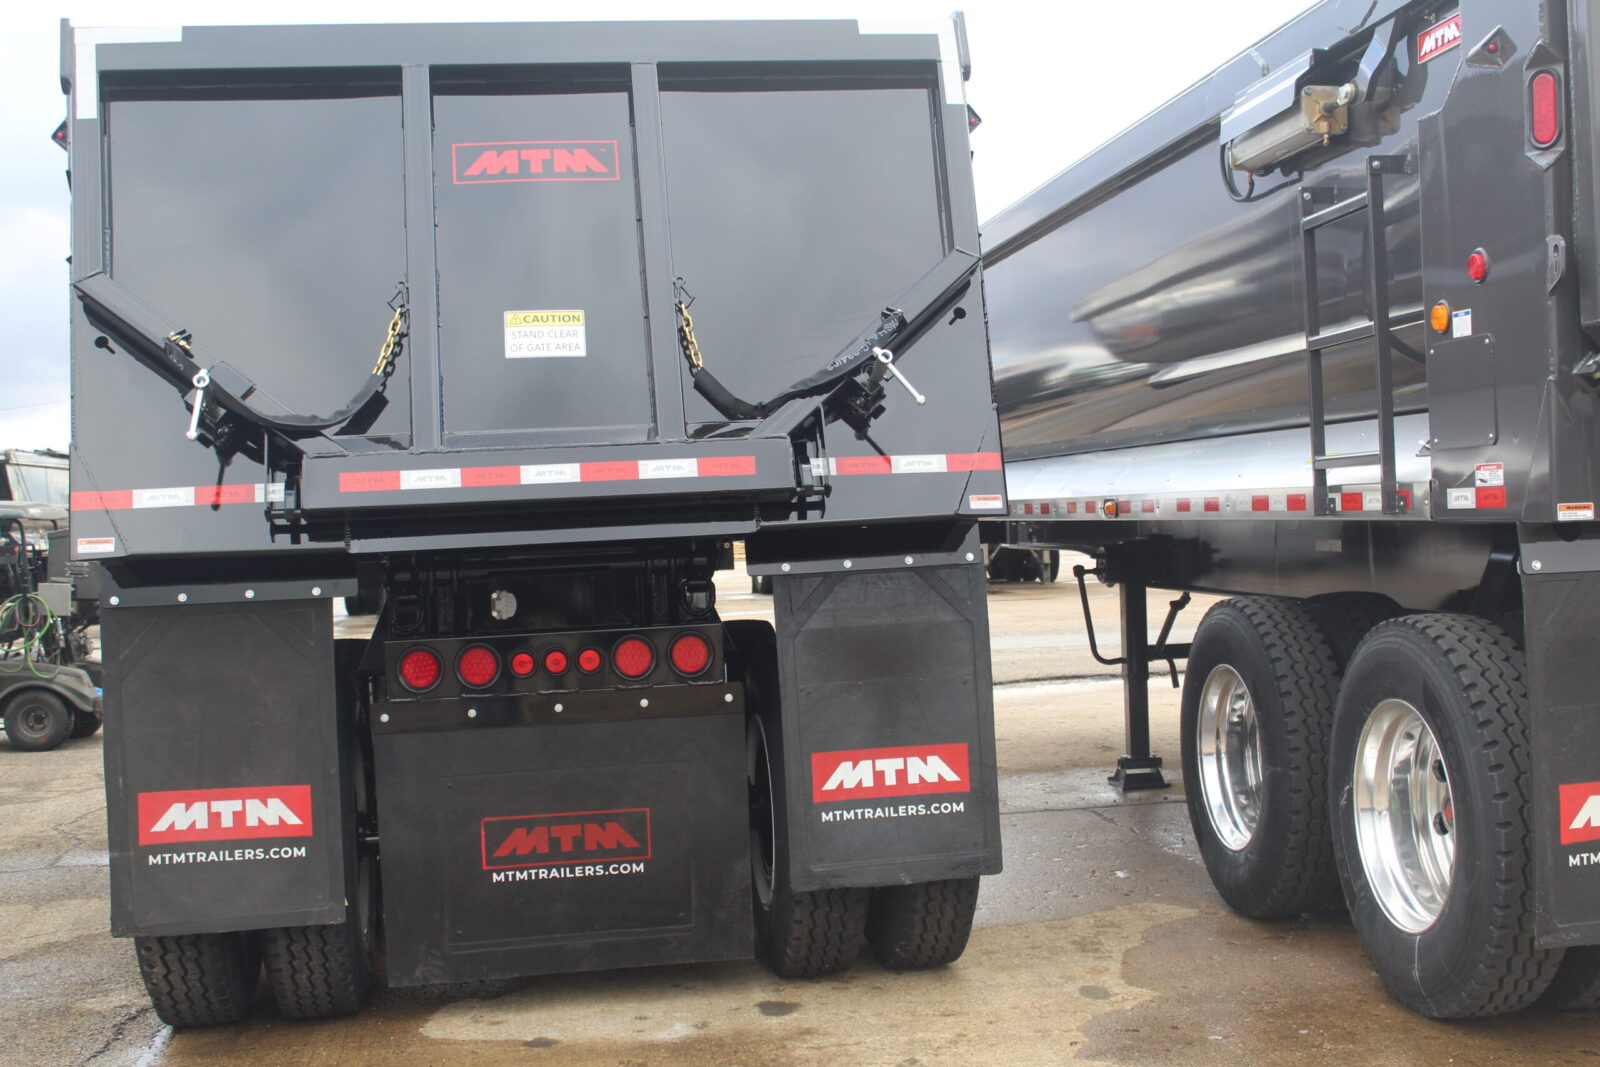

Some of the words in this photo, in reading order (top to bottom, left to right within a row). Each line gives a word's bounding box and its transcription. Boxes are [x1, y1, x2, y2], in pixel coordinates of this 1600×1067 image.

[1420, 22, 1461, 57] MTM
[463, 148, 609, 176] MTM
[523, 314, 580, 324] CAUTION
[511, 330, 544, 340] STAND
[547, 329, 579, 339] CLEAR
[510, 344, 524, 352] OF
[527, 343, 552, 352] GATE
[555, 342, 581, 351] AREA
[414, 474, 448, 483] MTM
[534, 469, 568, 478] MTM
[652, 464, 685, 473] MTM
[903, 459, 935, 468] MTM
[147, 493, 181, 502] MTM
[821, 755, 961, 791] MTM
[150, 798, 304, 832] MTM
[821, 802, 964, 823] MTMTRAILERS.COM
[493, 821, 641, 857] MTM
[148, 846, 307, 866] MTMTRAILERS.COM
[492, 862, 645, 883] MTMTRAILERS.COM
